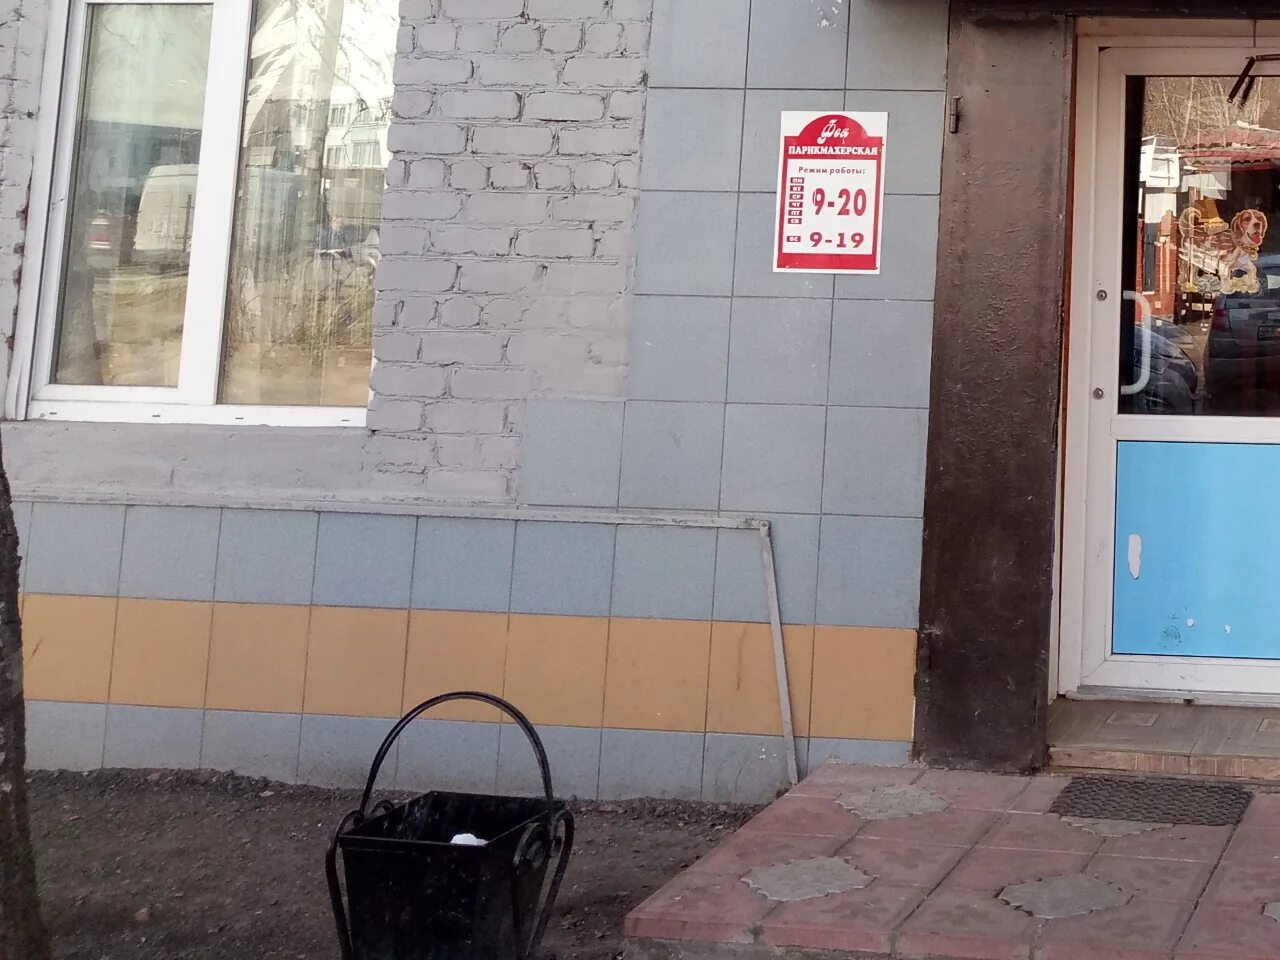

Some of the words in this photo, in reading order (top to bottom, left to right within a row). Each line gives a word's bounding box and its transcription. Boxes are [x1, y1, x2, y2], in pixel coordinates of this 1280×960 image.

[788, 146, 878, 155] ПАРИКМАХЕРСКАЯ
[798, 166, 828, 174] Режим
[829, 167, 866, 175] работы:
[812, 188, 867, 216] 9-20
[809, 232, 864, 248] 9-19
